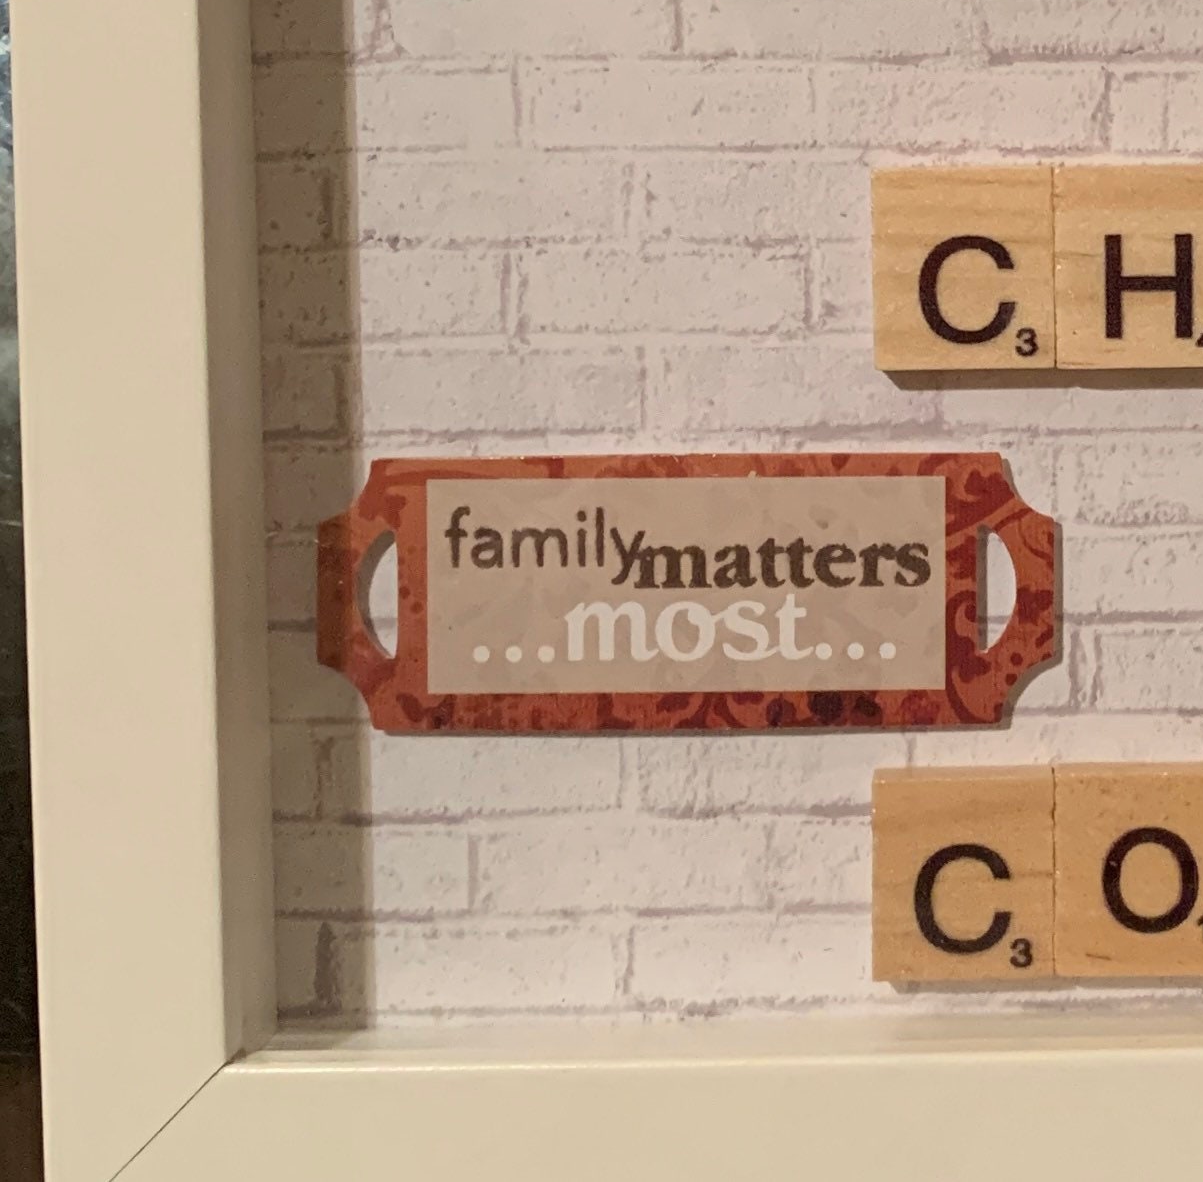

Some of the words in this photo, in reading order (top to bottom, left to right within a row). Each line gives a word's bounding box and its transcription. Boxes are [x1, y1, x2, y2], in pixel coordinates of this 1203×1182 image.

[1014, 328, 1040, 357] 3
[445, 505, 645, 585] family
[633, 535, 931, 589] matters
[1008, 938, 1034, 968] 3
